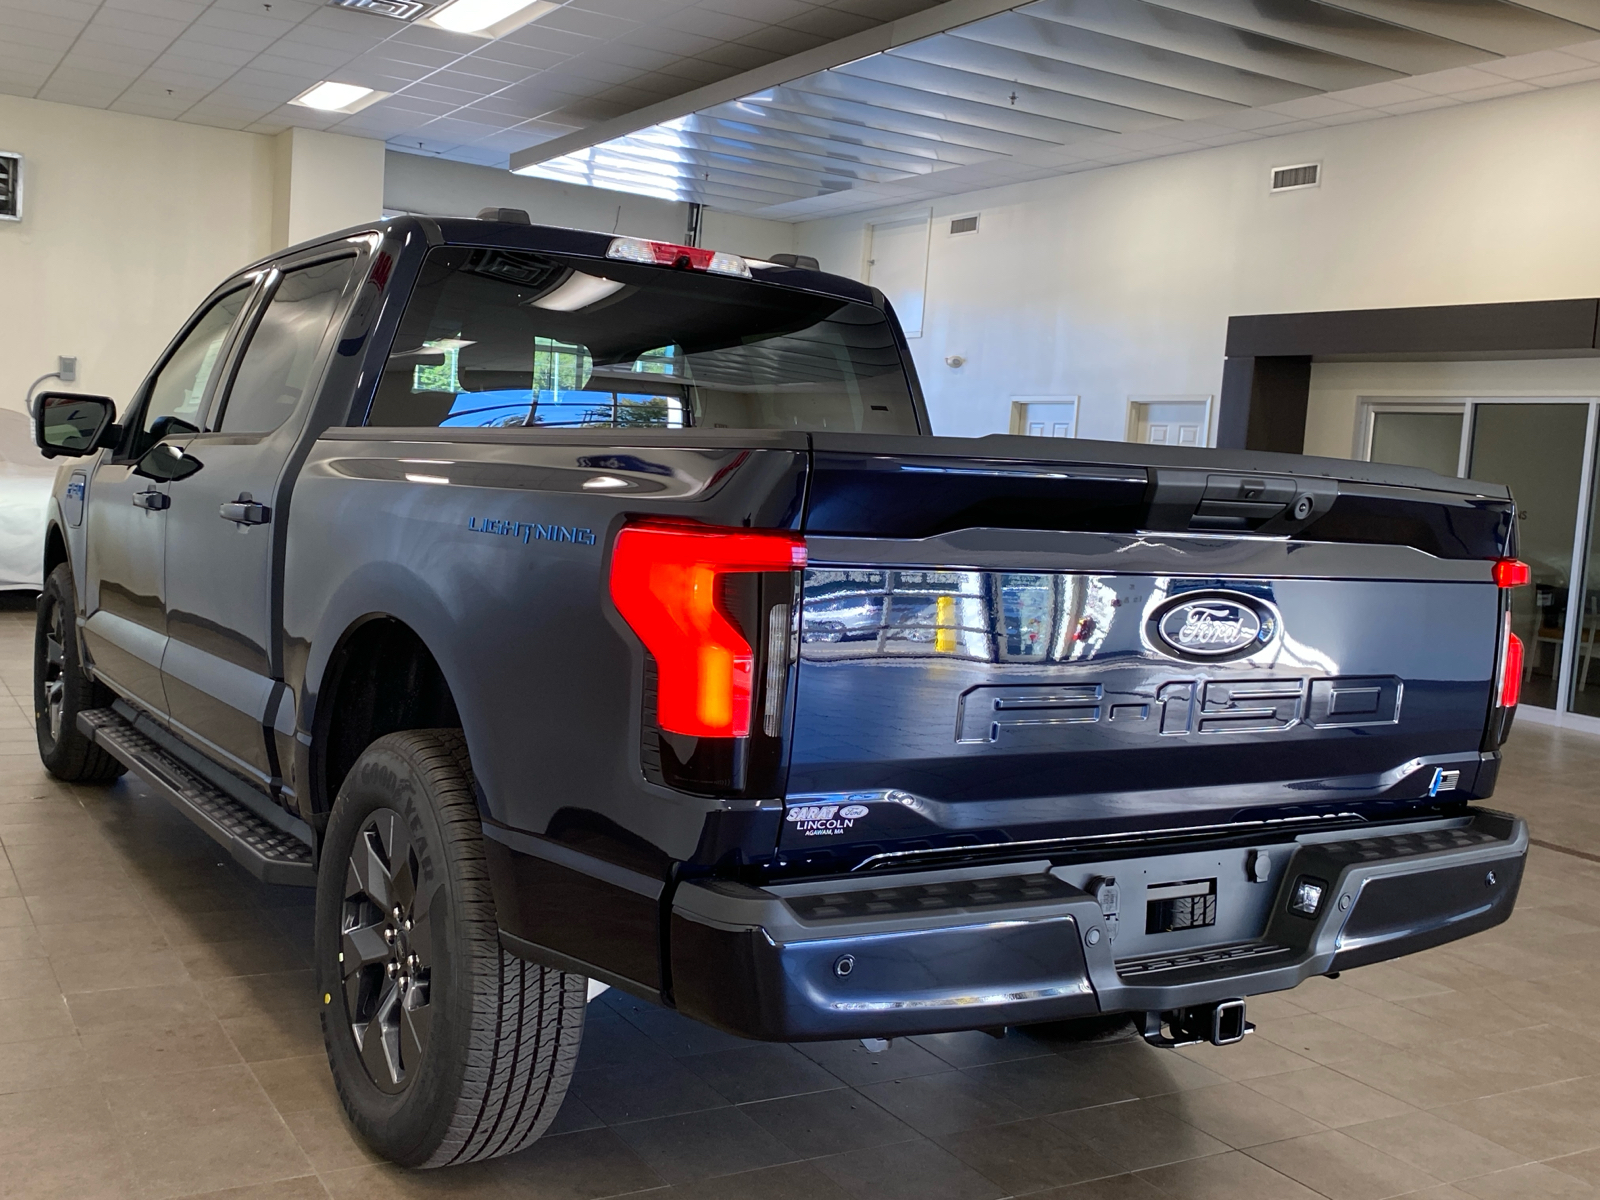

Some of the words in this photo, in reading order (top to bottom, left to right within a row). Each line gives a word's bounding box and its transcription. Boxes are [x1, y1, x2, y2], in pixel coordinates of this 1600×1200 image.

[468, 516, 597, 545] LIGHTNING
[1179, 607, 1244, 644] Ford
[955, 674, 1404, 744] F-150
[787, 806, 839, 821] SARAT
[797, 819, 854, 830] LINCOLN
